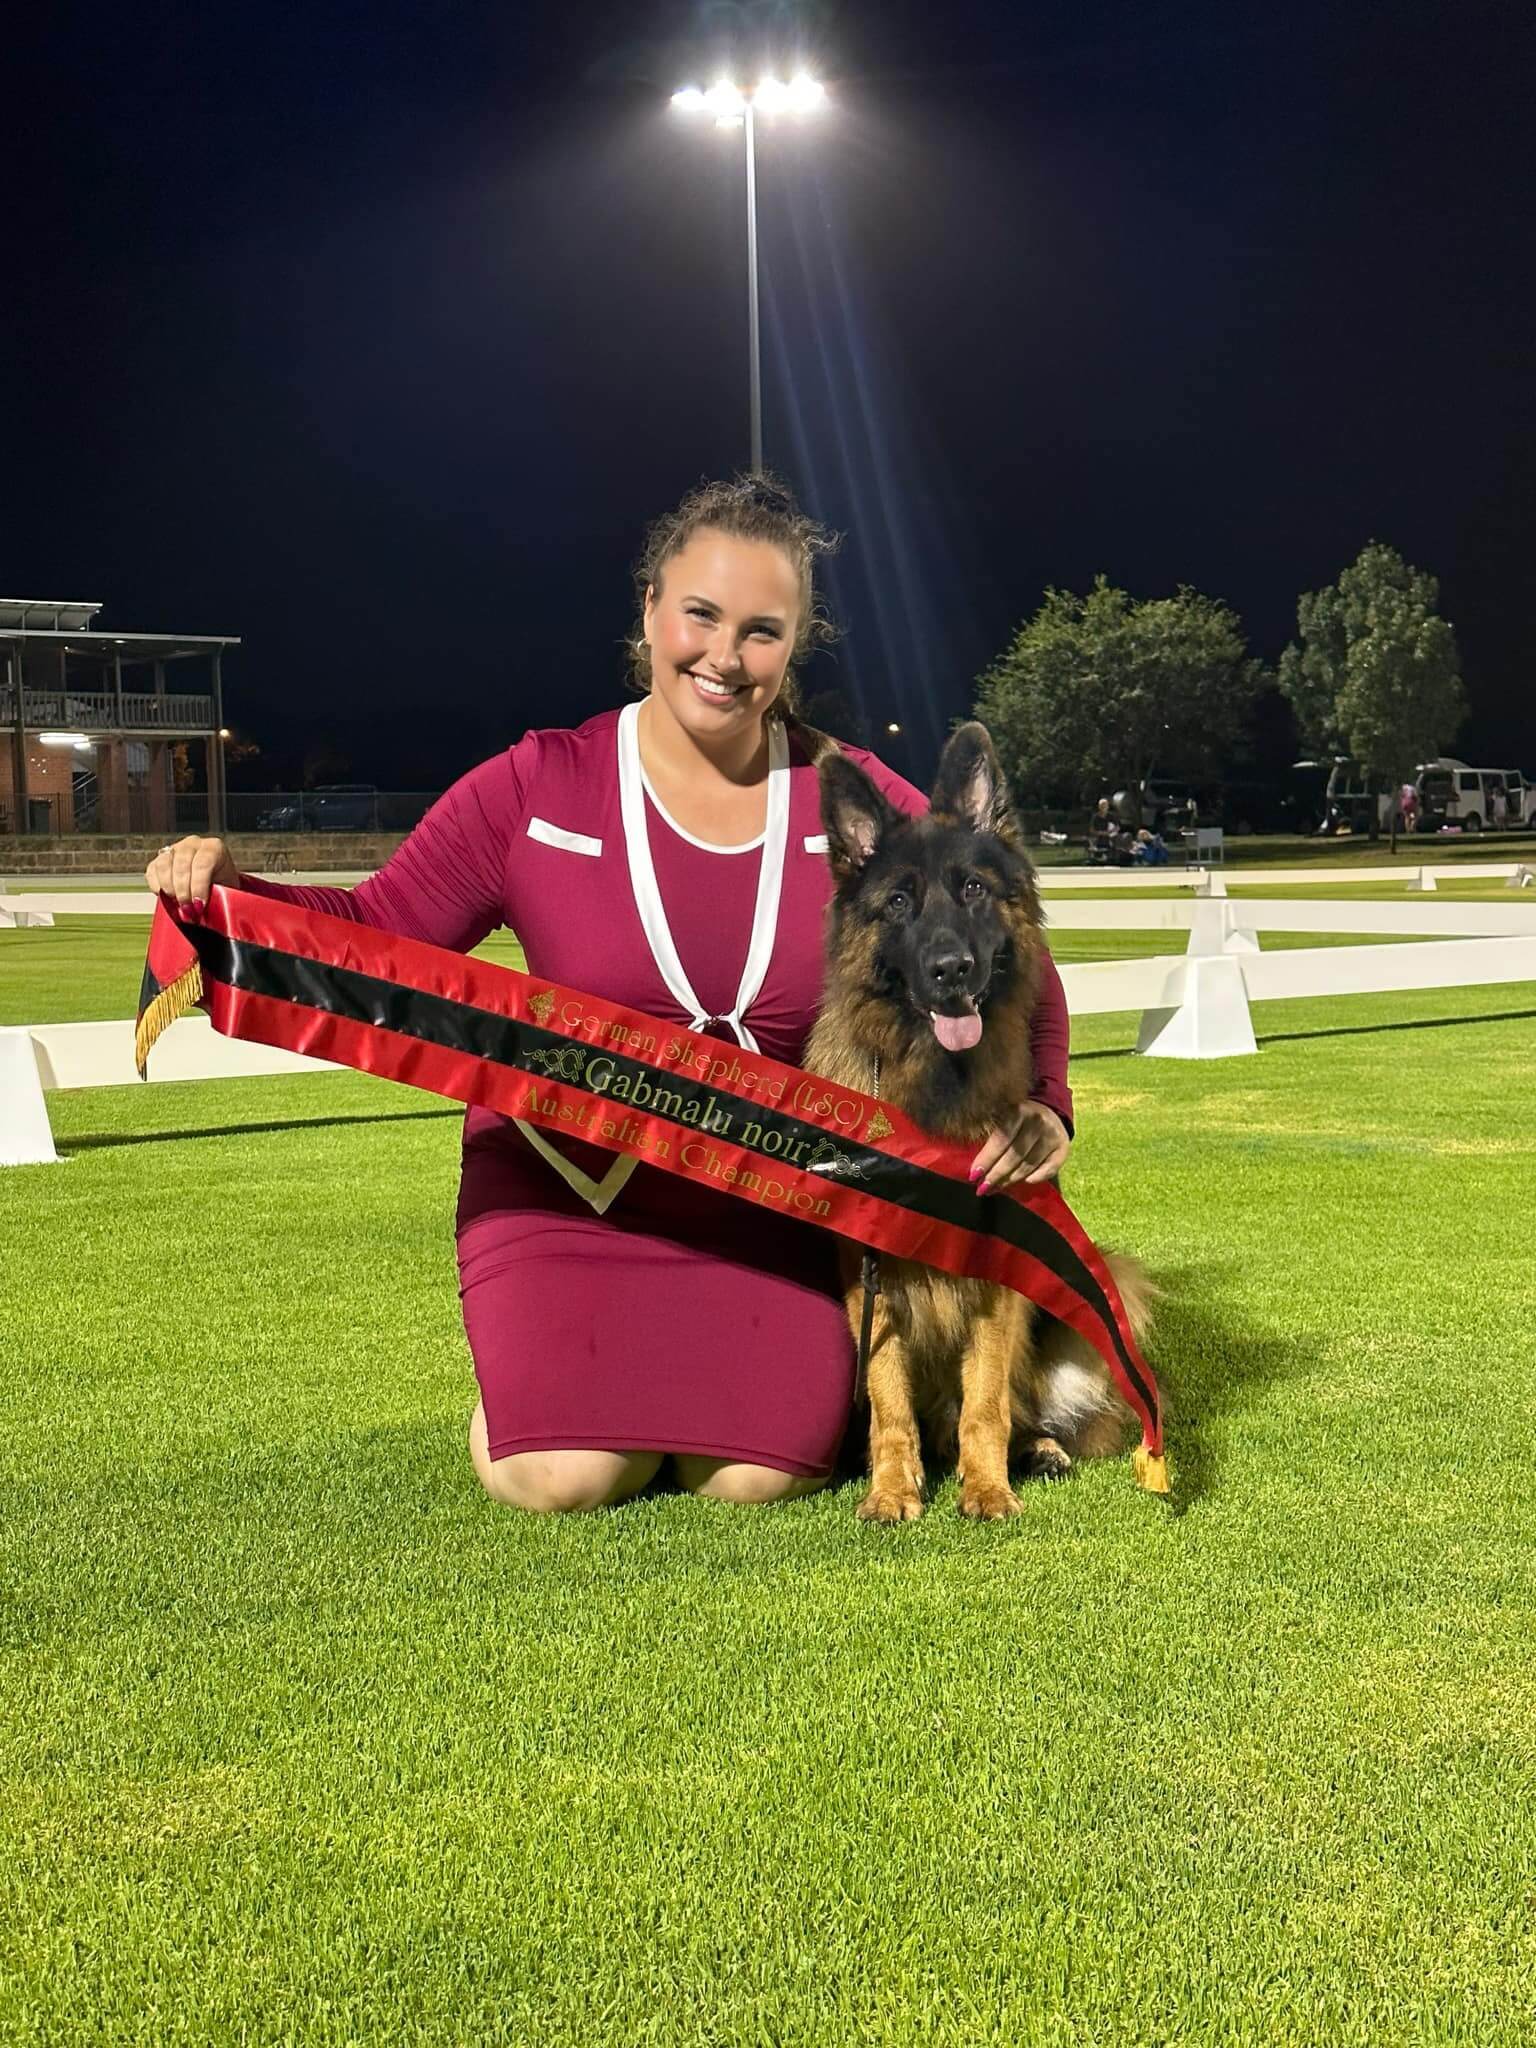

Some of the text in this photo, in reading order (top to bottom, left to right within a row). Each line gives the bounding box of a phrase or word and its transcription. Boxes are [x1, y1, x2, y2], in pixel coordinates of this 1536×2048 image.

[561, 1002, 864, 1132] German Shepherd (LSC)
[585, 1057, 811, 1163] Gabmalu noir
[519, 1086, 832, 1216] Australian Champion
